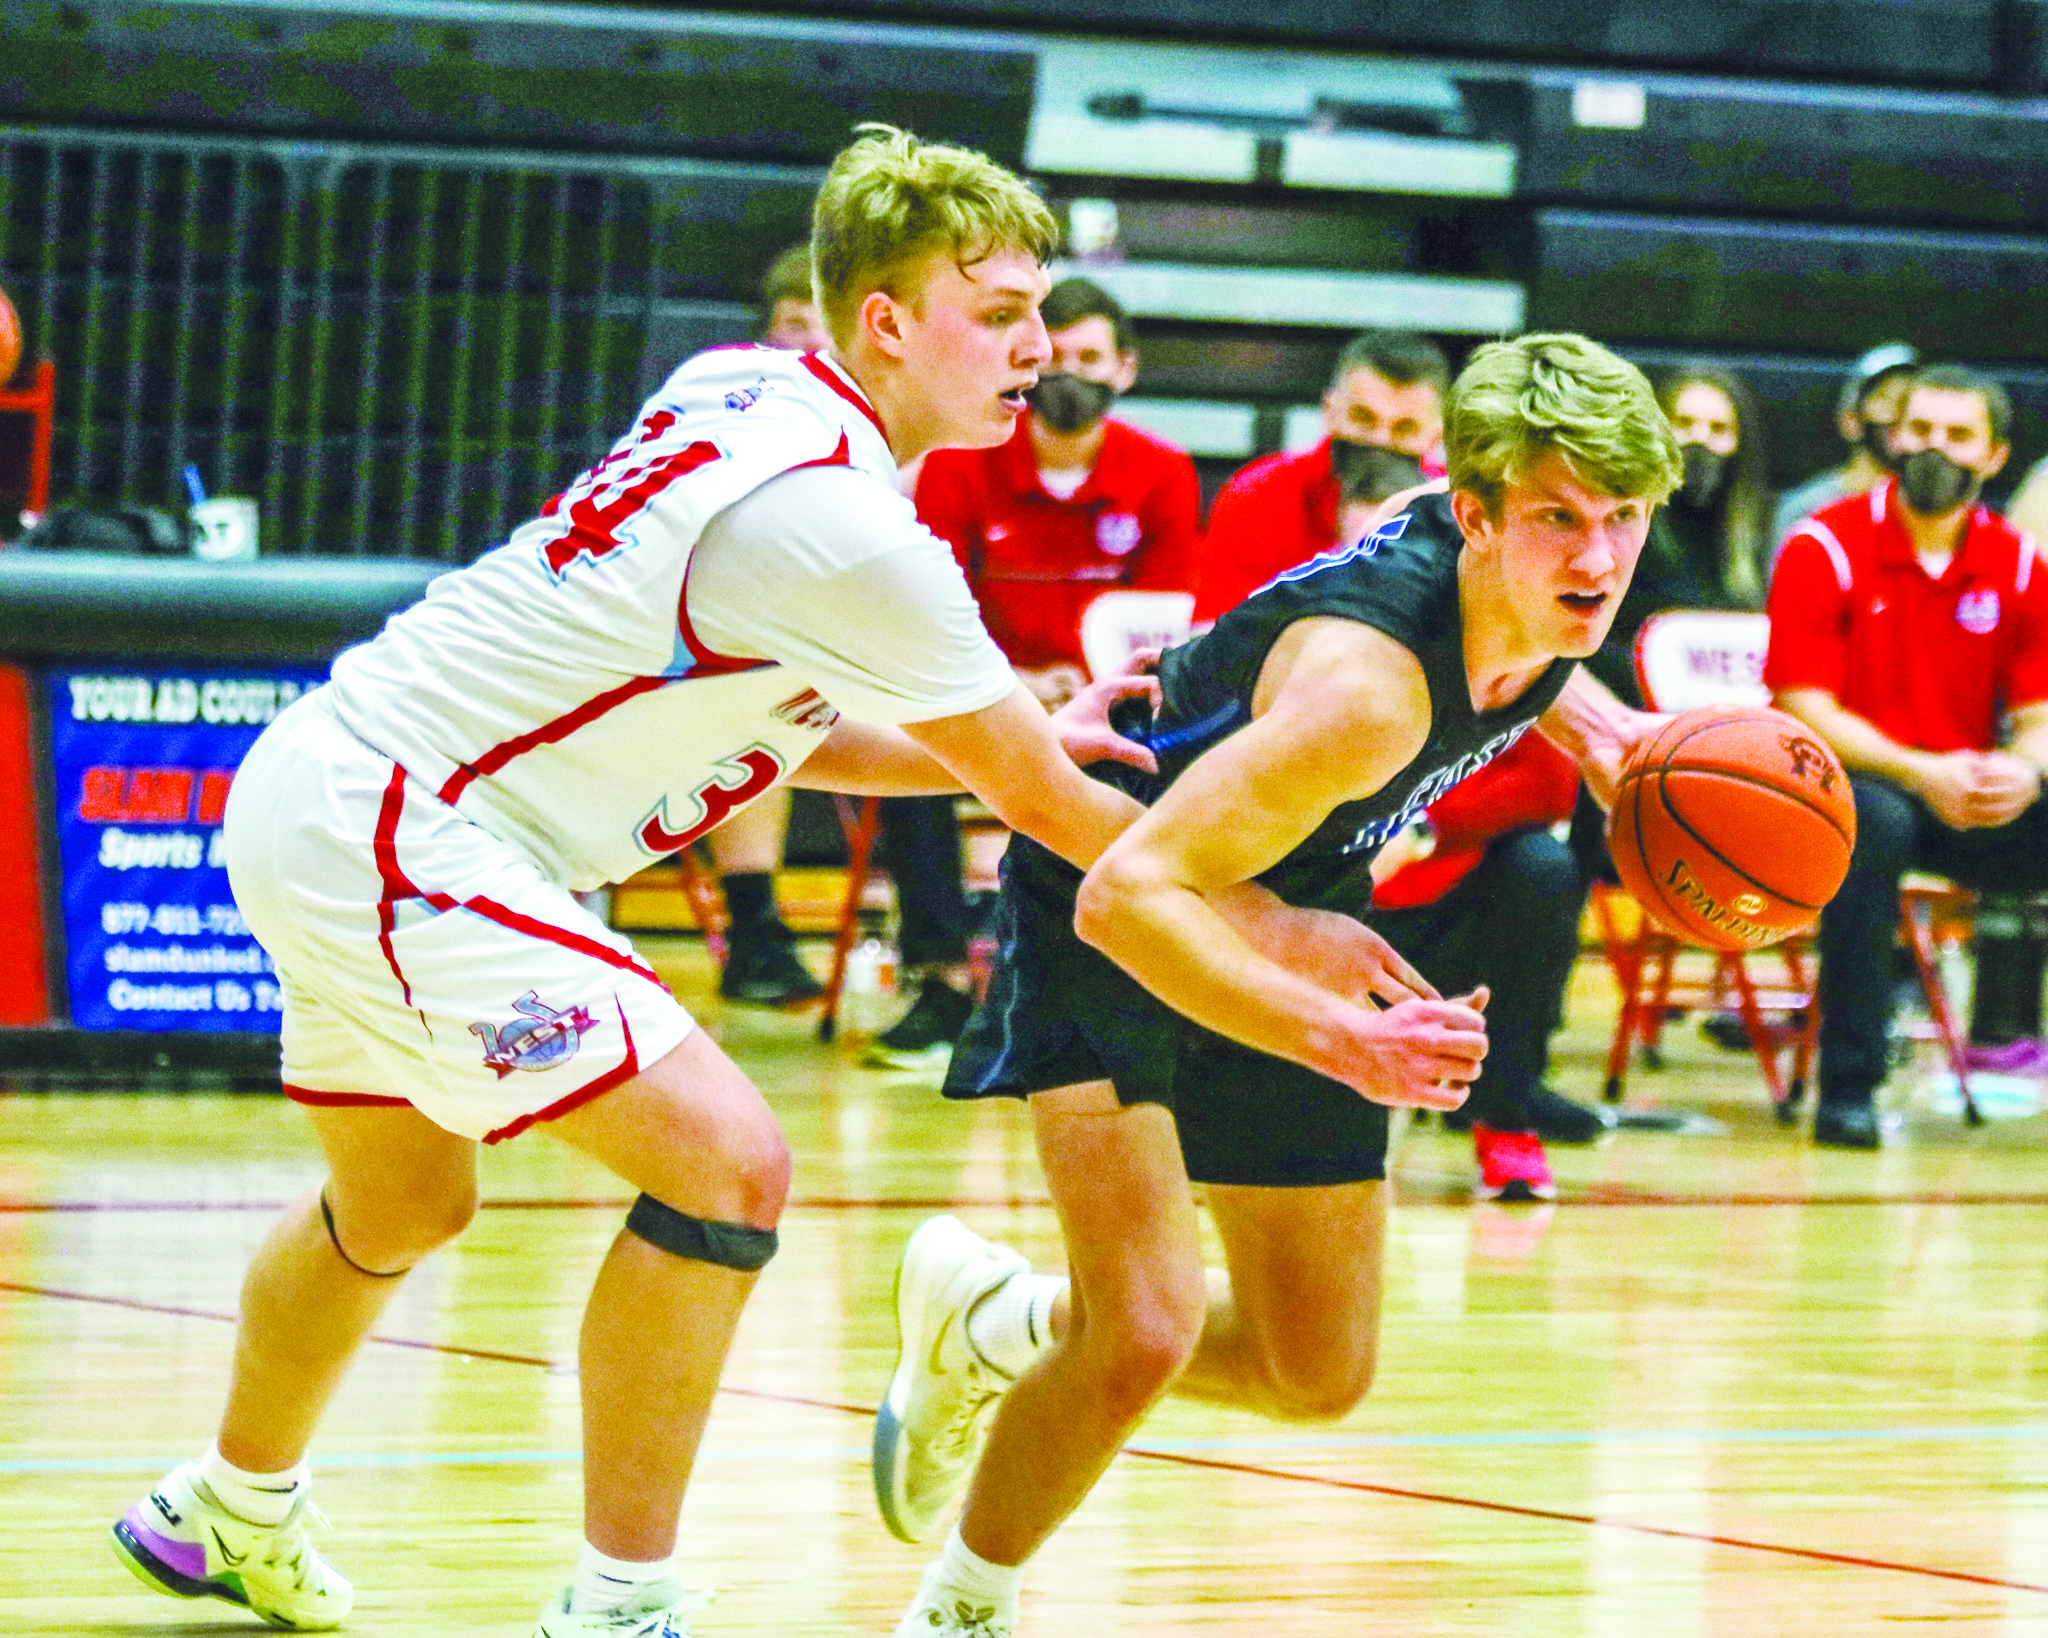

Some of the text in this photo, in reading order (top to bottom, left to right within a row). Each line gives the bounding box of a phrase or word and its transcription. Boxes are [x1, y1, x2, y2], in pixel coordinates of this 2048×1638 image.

[70, 676, 151, 722] YOUR
[154, 677, 199, 722] AD
[80, 767, 193, 823] SLAM
[99, 827, 202, 870] Sports
[107, 978, 213, 1011] Contact
